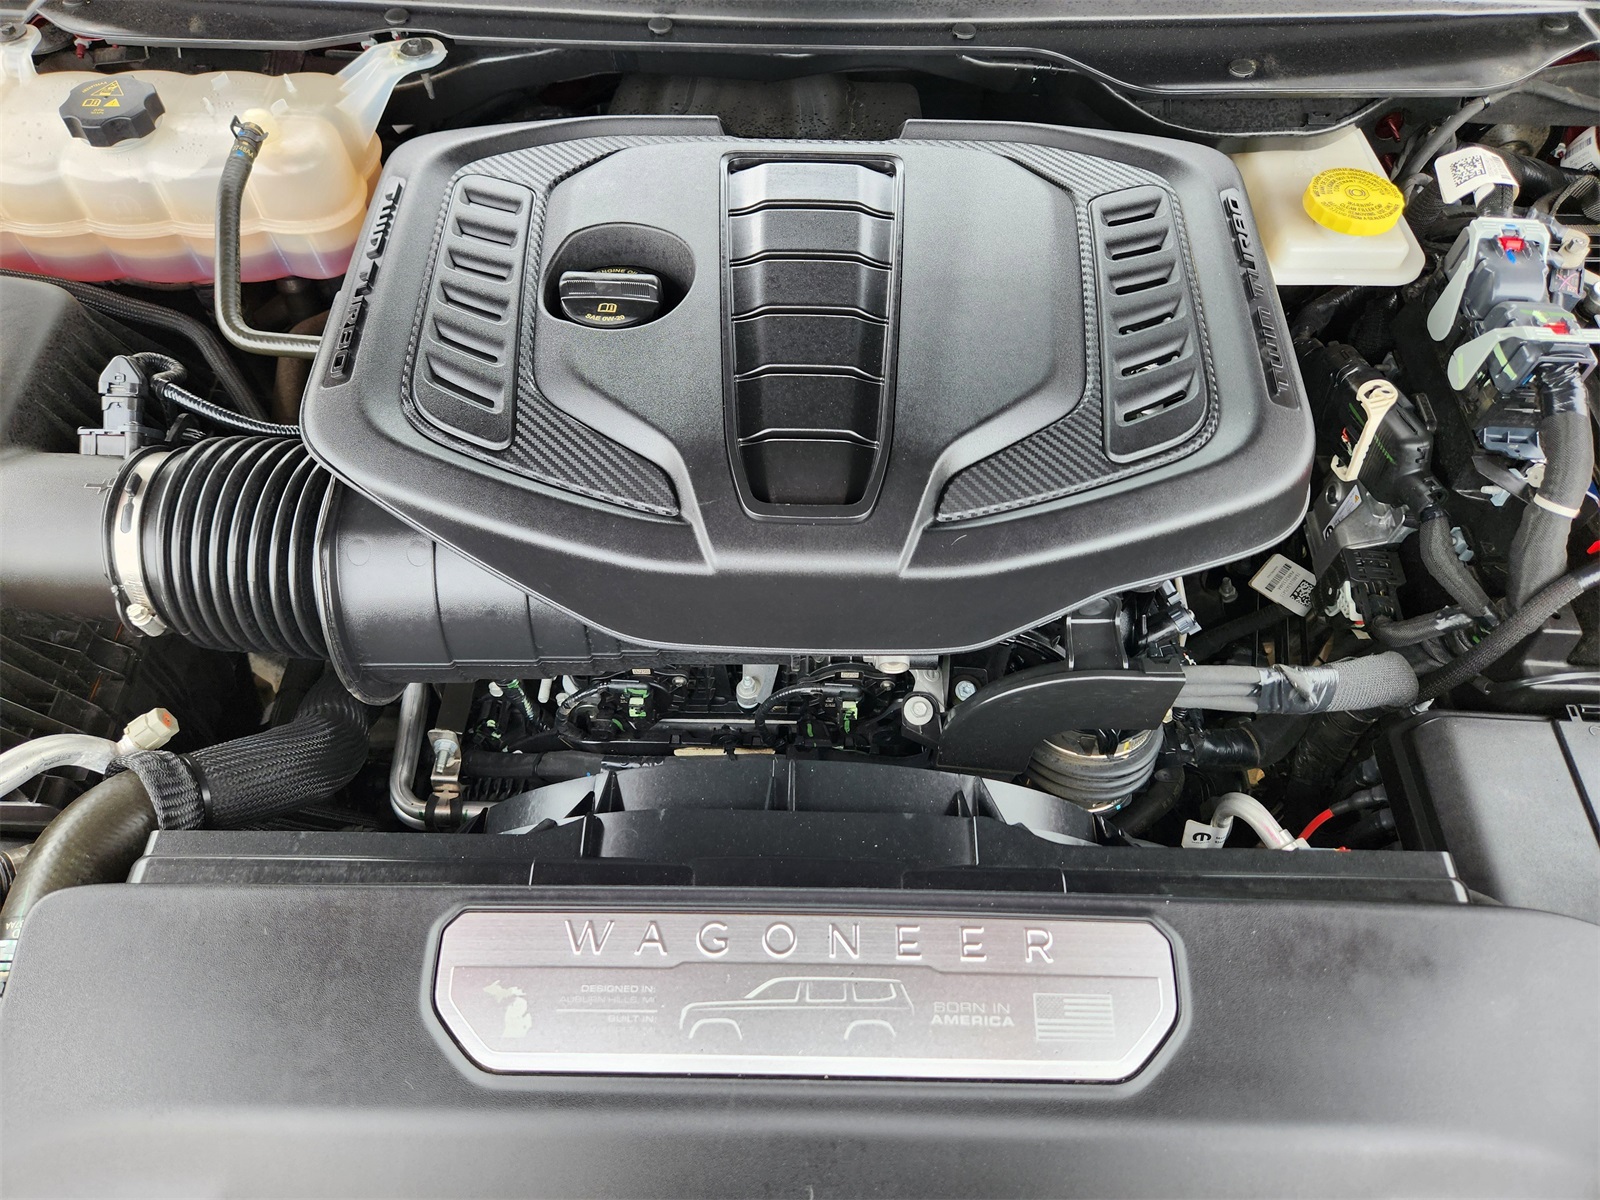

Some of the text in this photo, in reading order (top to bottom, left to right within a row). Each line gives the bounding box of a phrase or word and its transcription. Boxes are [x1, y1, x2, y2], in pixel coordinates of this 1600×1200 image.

[1224, 195, 1288, 396] TWIN TURBO
[330, 259, 380, 378] TURBO
[585, 313, 601, 321] SAE
[564, 919, 1055, 964] WAGONEER
[580, 984, 657, 994] DESIGNED IN:
[933, 1002, 1010, 1014] BORN IN
[607, 1014, 658, 1024] BUILT IN:
[930, 1014, 1016, 1028] AMERICA
